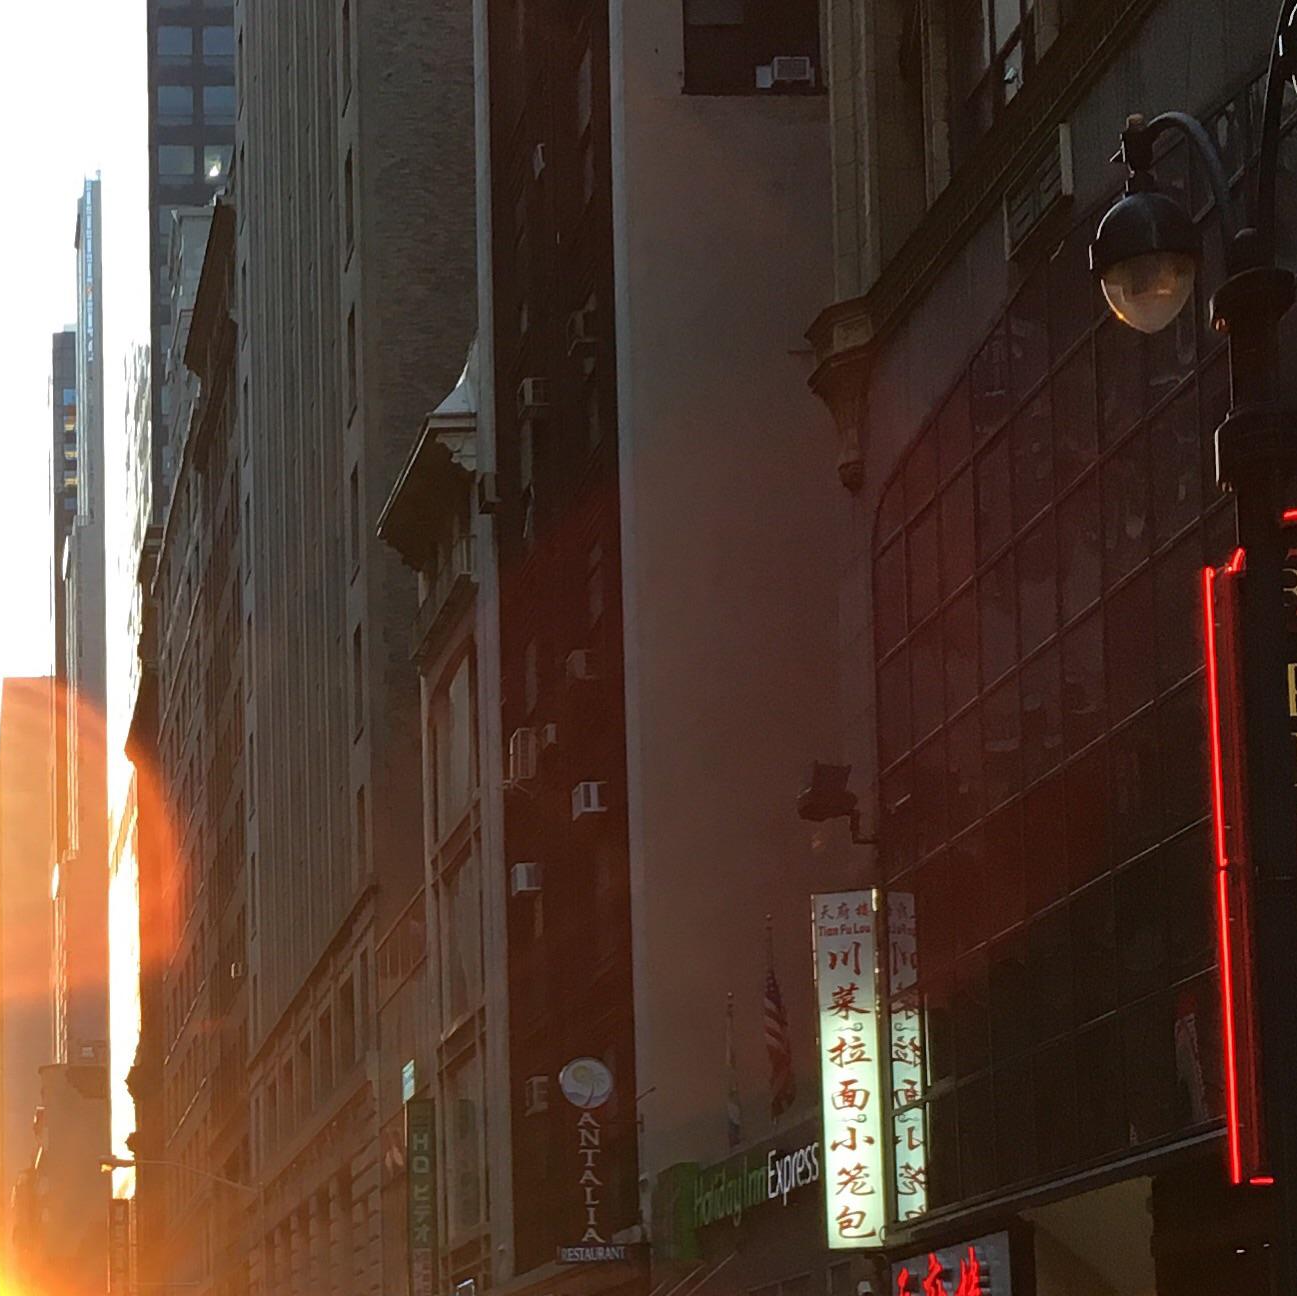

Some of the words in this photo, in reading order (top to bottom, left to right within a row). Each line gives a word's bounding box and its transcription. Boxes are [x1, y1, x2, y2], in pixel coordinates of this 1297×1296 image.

[818, 925, 839, 936] Tian
[577, 1111, 606, 1243] ANTALIA
[768, 1142, 820, 1207] Express
[560, 1245, 625, 1262] RESTAURANT
